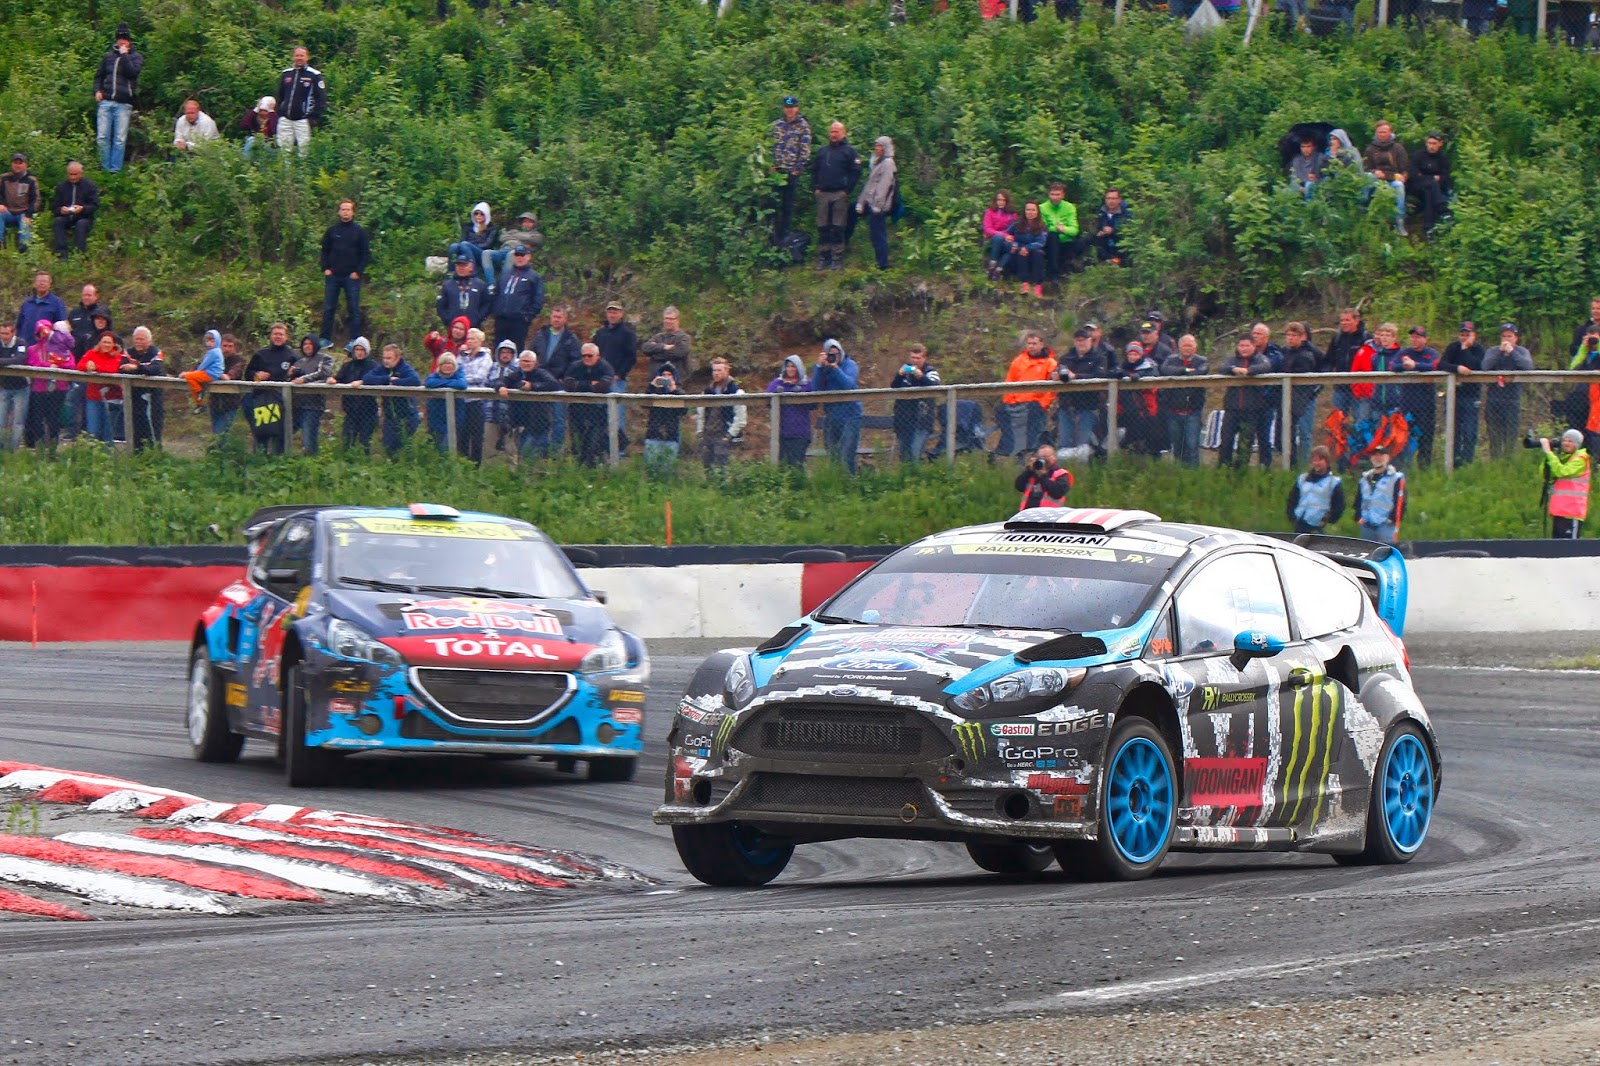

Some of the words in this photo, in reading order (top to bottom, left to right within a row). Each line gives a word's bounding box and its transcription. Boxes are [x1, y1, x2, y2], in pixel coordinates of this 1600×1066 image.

[975, 545, 1096, 558] RALLYCROSSRX
[407, 613, 482, 628] Red
[491, 615, 561, 634] Bull
[425, 638, 560, 660] TOTAL
[836, 658, 900, 671] Ford
[681, 705, 704, 721] Castrol
[1002, 724, 1033, 735] Castrol
[1037, 714, 1105, 737] EDGE
[684, 734, 712, 748] GoPro
[1005, 746, 1078, 759] GoPro
[1191, 767, 1259, 795] HOONIGAN
